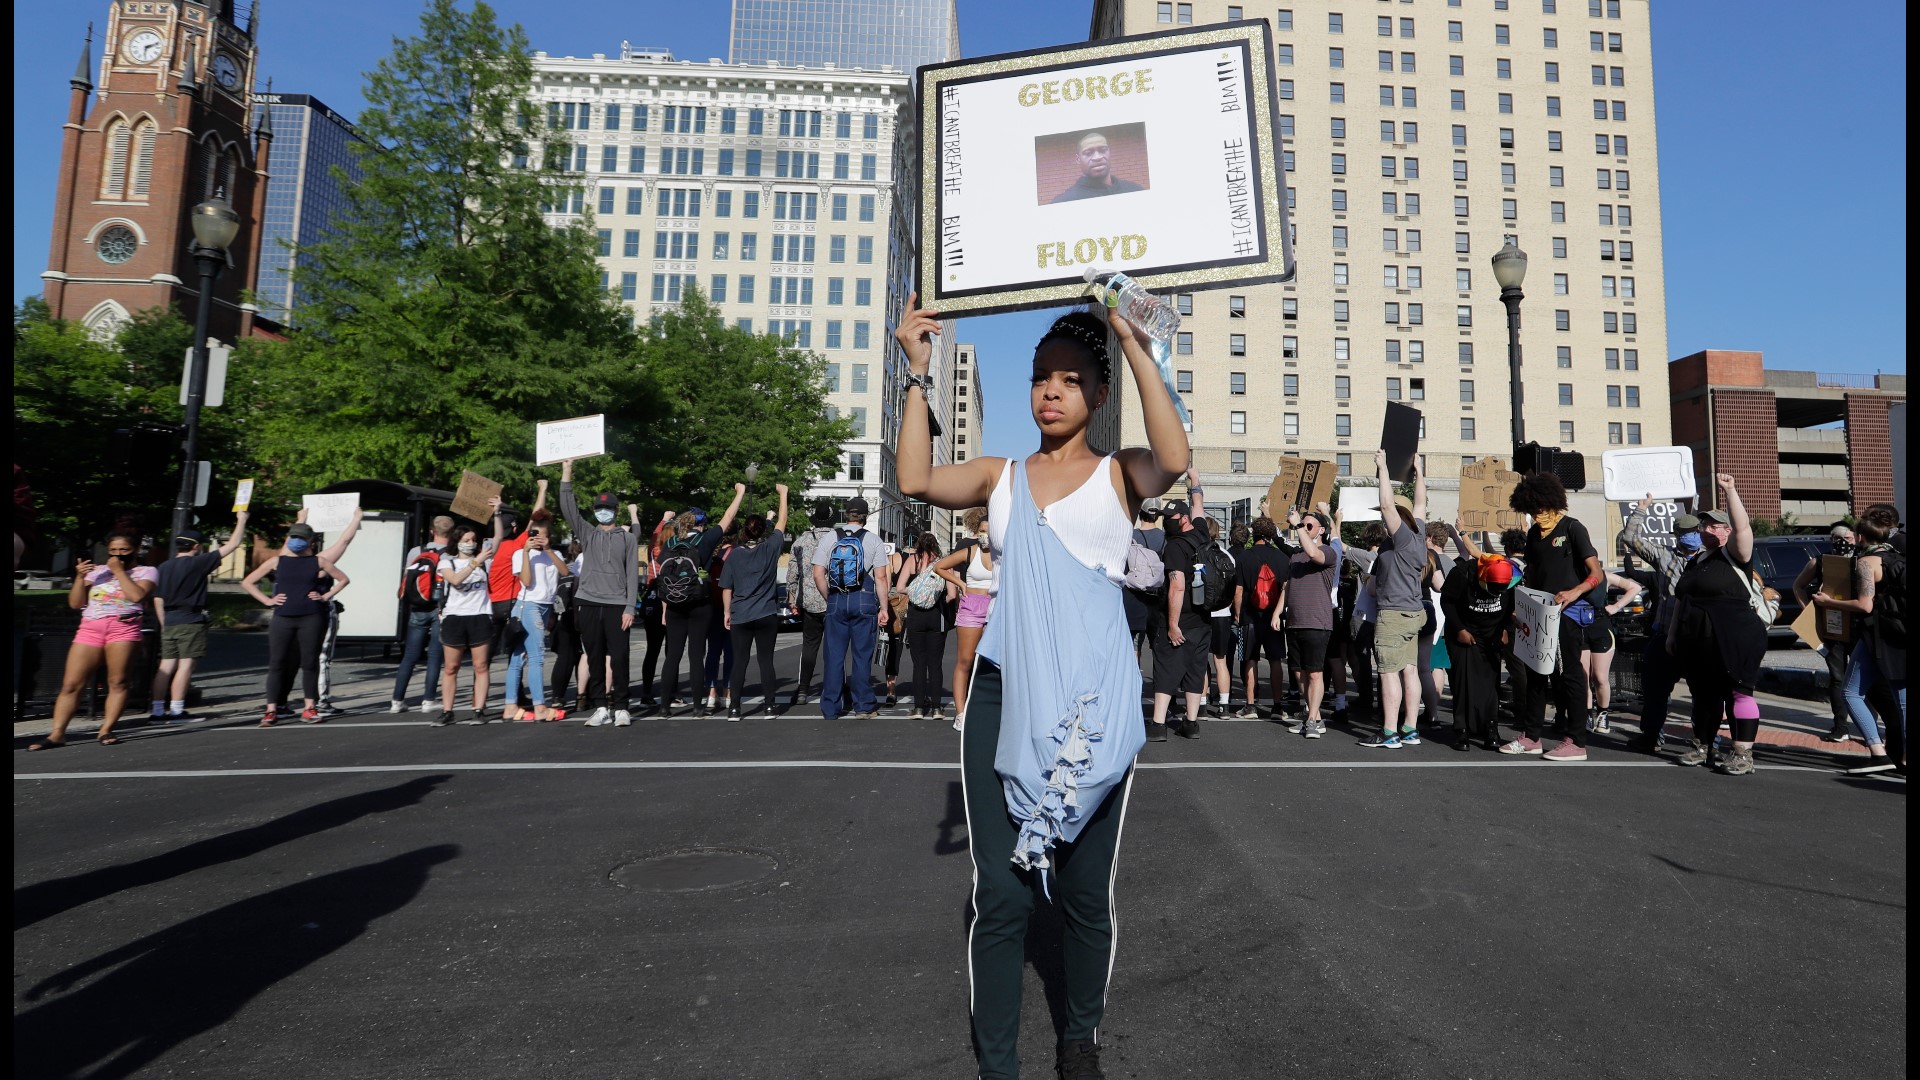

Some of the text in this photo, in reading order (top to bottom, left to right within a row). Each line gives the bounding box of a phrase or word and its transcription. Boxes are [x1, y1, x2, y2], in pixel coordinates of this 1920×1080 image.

[1018, 68, 1155, 107] GEORGE
[1216, 59, 1242, 113] BLM!!!
[942, 215, 964, 268] BLM!!!
[1036, 233, 1149, 269] FLOYD
